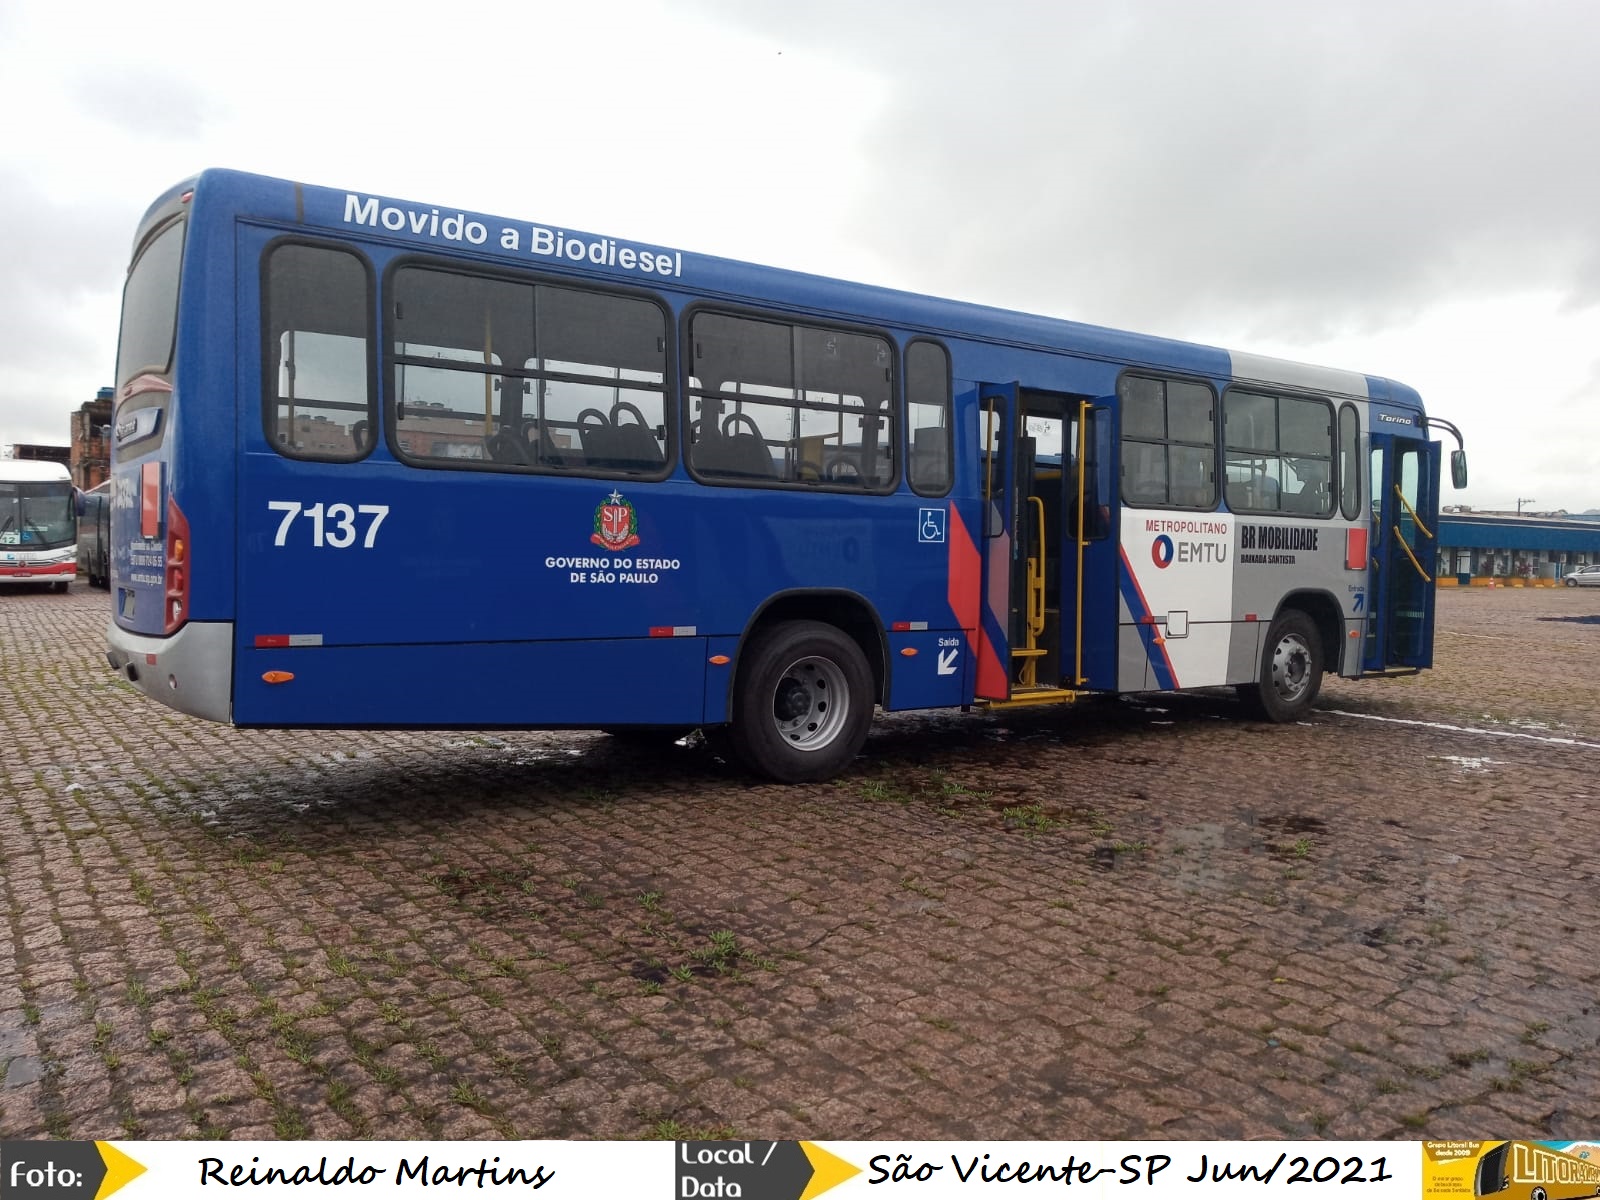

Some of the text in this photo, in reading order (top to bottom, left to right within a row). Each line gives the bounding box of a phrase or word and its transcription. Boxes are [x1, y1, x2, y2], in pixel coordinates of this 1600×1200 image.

[343, 194, 683, 278] Movido a Biodiesel
[1379, 413, 1412, 425] Torino
[268, 500, 390, 549] 7137
[1145, 519, 1228, 535] METROPOLITANO
[1241, 525, 1319, 551] BR MOBILIDADE
[1177, 542, 1227, 563] EMTU
[545, 557, 681, 570] GOVERNO DO ESTADO
[570, 570, 659, 584] DE SÃO PAULO
